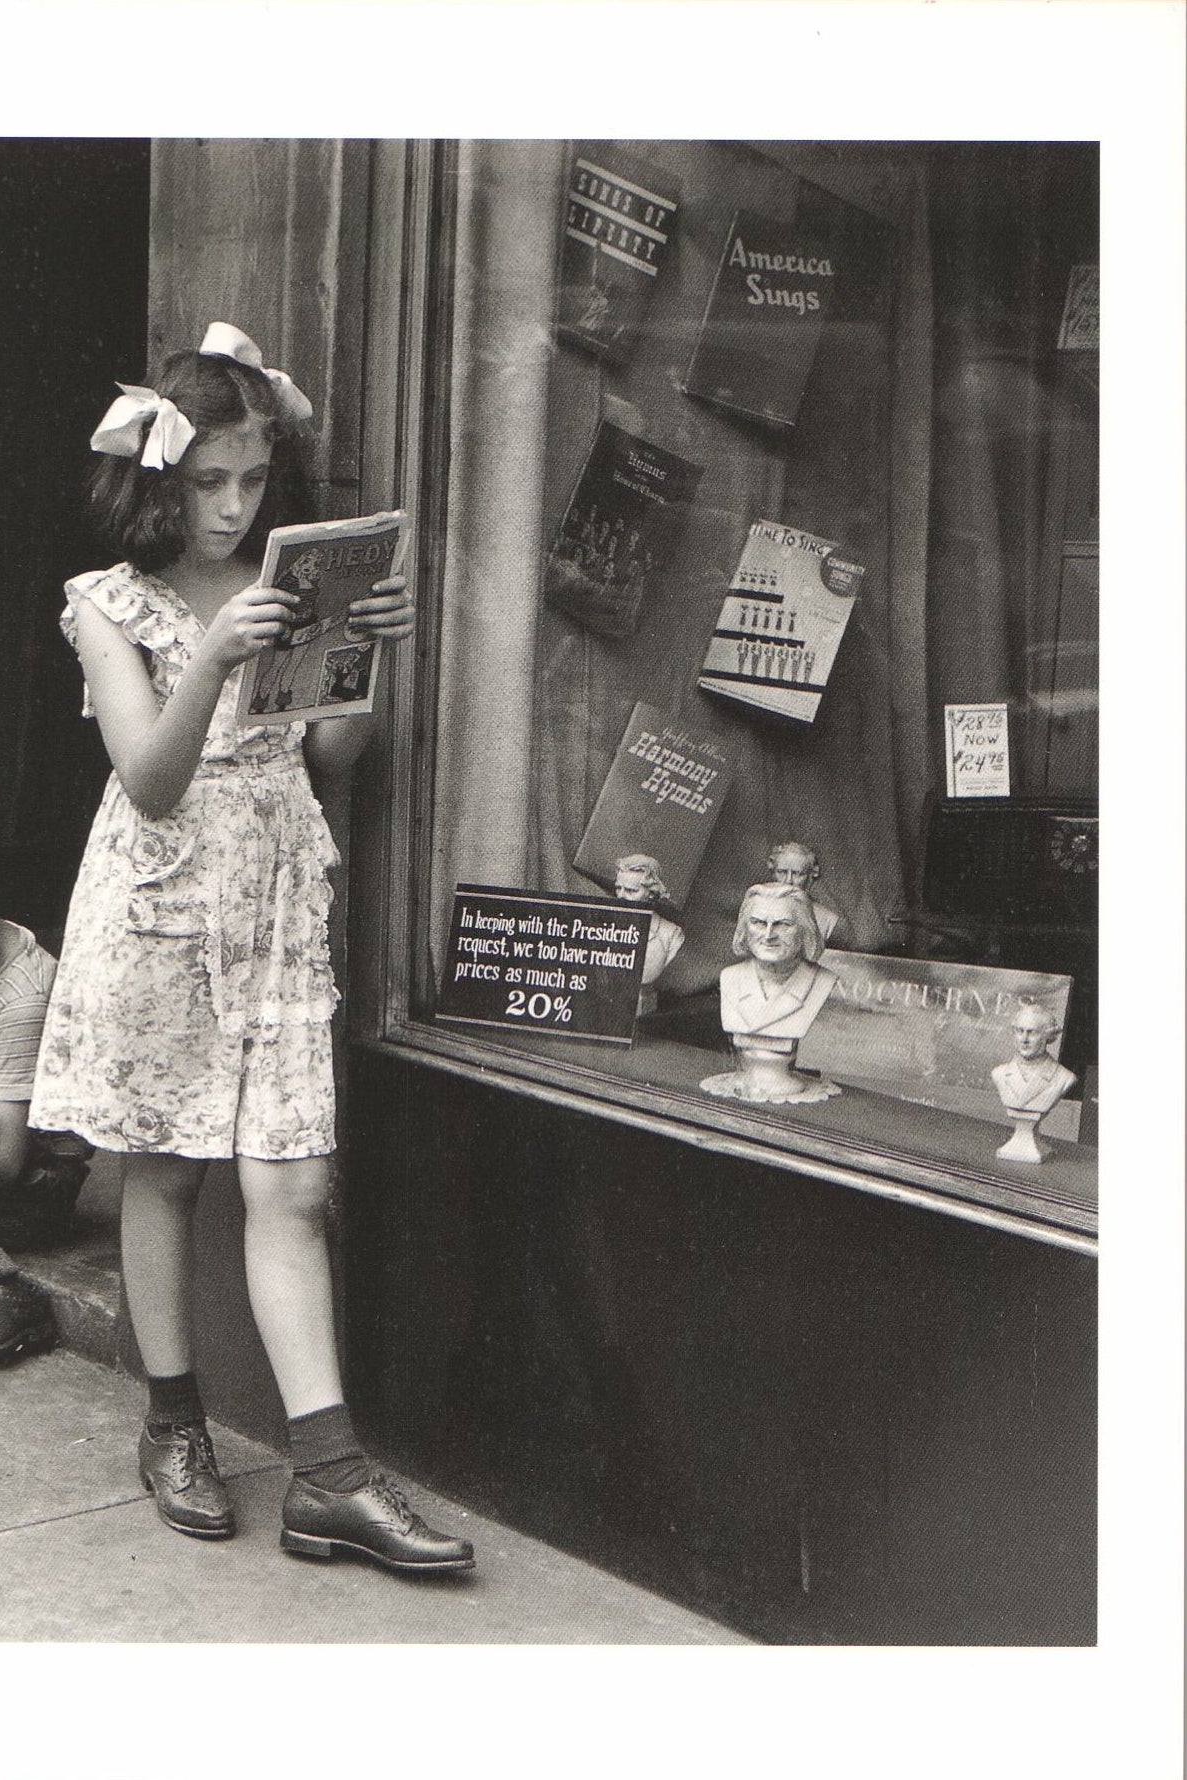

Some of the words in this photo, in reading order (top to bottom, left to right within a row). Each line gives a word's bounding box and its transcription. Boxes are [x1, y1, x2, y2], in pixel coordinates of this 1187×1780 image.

[645, 204, 666, 228] OF
[729, 237, 834, 276] America
[746, 273, 820, 316] Sings
[627, 731, 719, 793] Harmony
[640, 765, 714, 815] Hymns
[460, 907, 474, 928] In
[474, 909, 516, 936] keeping
[518, 915, 544, 935] with
[546, 917, 569, 937] the
[571, 918, 641, 945] President's
[457, 936, 510, 962] request,
[513, 940, 534, 958] we
[537, 940, 558, 960] too
[559, 941, 589, 965] have
[589, 946, 636, 970] reduced
[454, 961, 501, 982] prices
[505, 966, 523, 983] as
[525, 968, 566, 990] much
[569, 974, 588, 991] as
[505, 989, 573, 1023] 20%
